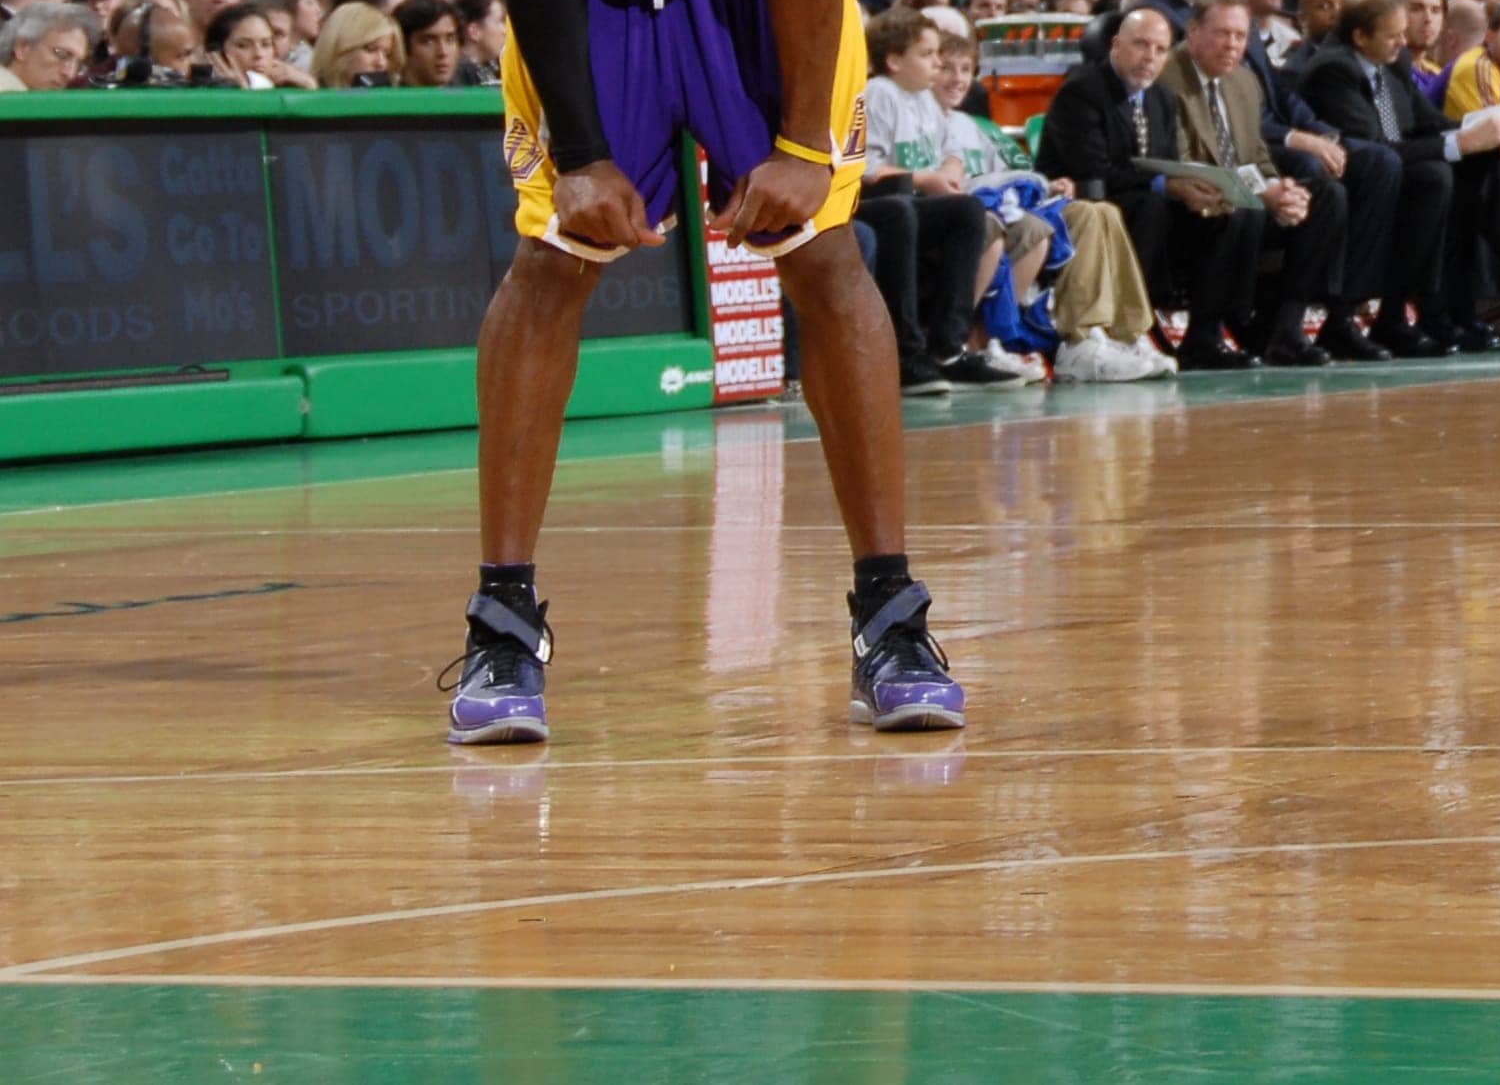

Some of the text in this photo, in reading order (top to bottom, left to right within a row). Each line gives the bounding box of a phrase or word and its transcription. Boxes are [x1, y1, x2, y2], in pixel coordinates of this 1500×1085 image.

[710, 277, 782, 306] MODELL'S
[0, 303, 155, 348] OODS
[713, 316, 784, 346] MODELL'S
[715, 355, 785, 385] MODELL'S
